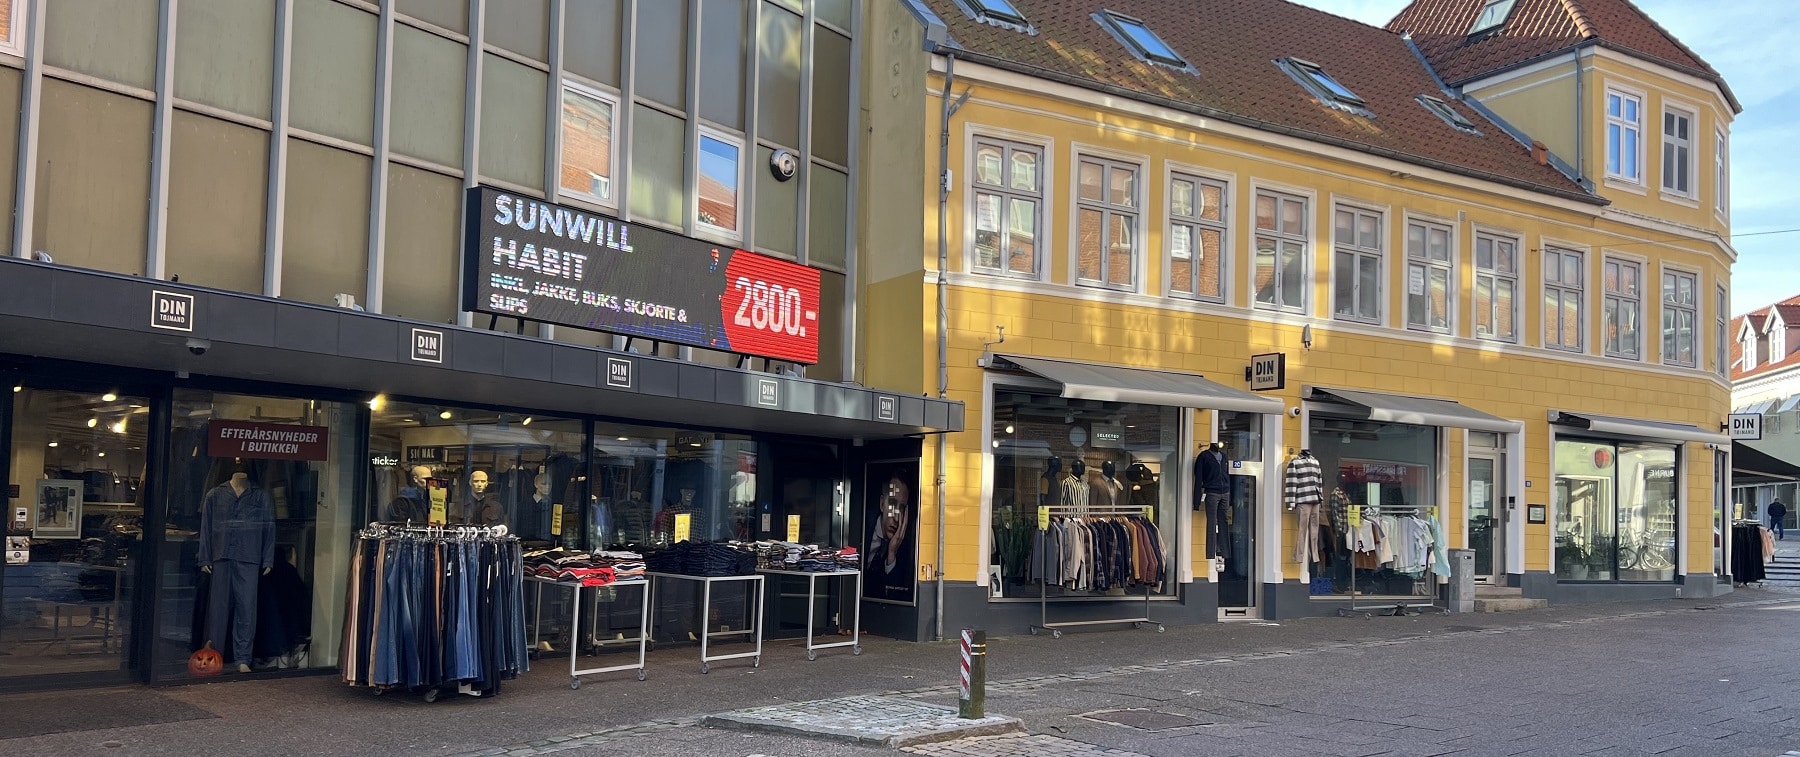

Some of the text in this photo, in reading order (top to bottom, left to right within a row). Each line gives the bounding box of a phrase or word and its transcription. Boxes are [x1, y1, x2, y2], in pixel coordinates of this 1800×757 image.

[494, 194, 633, 253] SUNWILL
[492, 236, 588, 281] HABIT
[159, 298, 186, 316] DIN
[489, 293, 528, 314] SLIPS
[531, 281, 580, 305] JAKKE,
[582, 290, 621, 313] BUKS,
[624, 298, 676, 320] SKJORTE
[677, 308, 687, 323] &
[417, 335, 437, 350] DIN
[612, 363, 627, 376] DIN
[1256, 360, 1274, 375] DIN
[762, 384, 775, 396] DIN
[881, 401, 892, 411] DIN
[1734, 418, 1754, 429] DIN
[220, 426, 318, 443] EFTERÅRSNYHEDER
[240, 441, 299, 454] I BUTIKKEN
